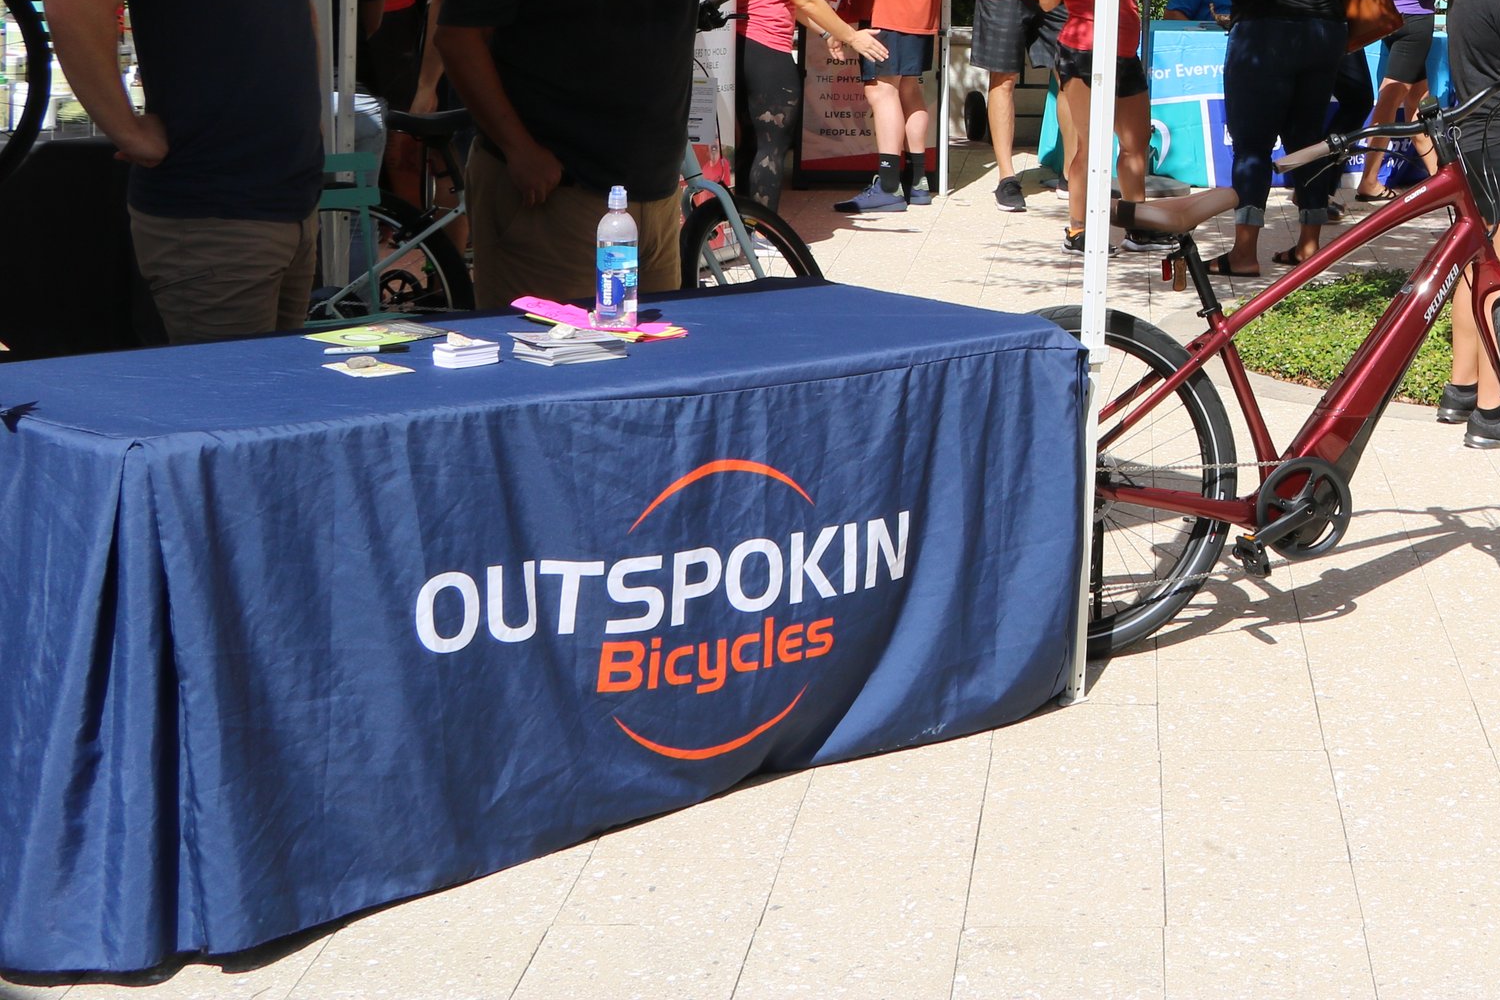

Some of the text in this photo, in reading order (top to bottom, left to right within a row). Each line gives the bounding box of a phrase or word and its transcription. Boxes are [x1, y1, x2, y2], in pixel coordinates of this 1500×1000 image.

[712, 47, 728, 56] HOLD
[820, 93, 840, 101] AND
[825, 111, 852, 119] LIVES
[854, 111, 865, 119] OF
[820, 128, 872, 137] PEOPLE AS
[1424, 263, 1460, 324] SPECIALIZED
[415, 510, 911, 654] OUTSPOKIN
[596, 617, 835, 695] Bicycles
